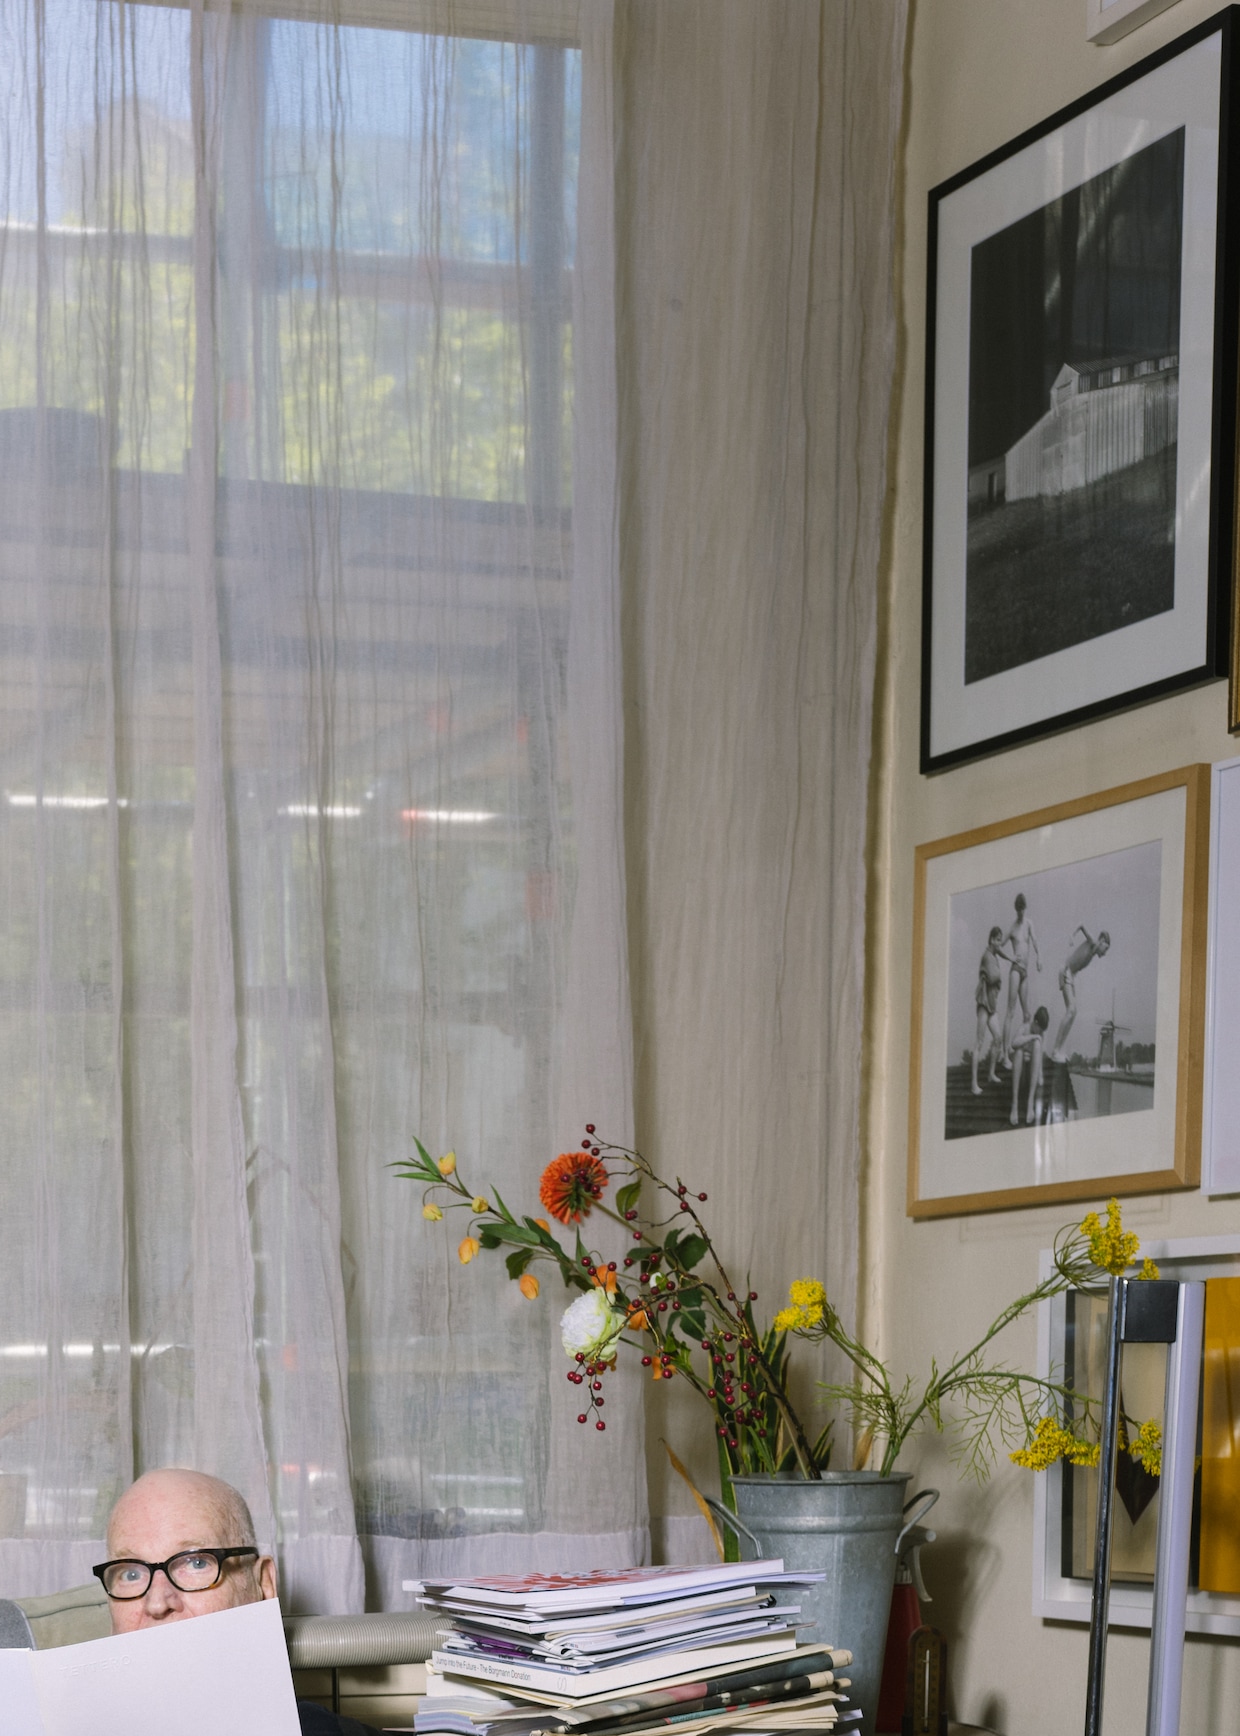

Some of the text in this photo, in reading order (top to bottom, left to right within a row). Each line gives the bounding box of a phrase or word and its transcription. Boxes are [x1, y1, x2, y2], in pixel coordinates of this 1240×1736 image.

[436, 1656, 447, 1666] Jump
[463, 1661, 477, 1671] Future
[480, 1664, 488, 1673] The
[489, 1666, 510, 1677] Borgmann
[511, 1669, 531, 1680] Donation
